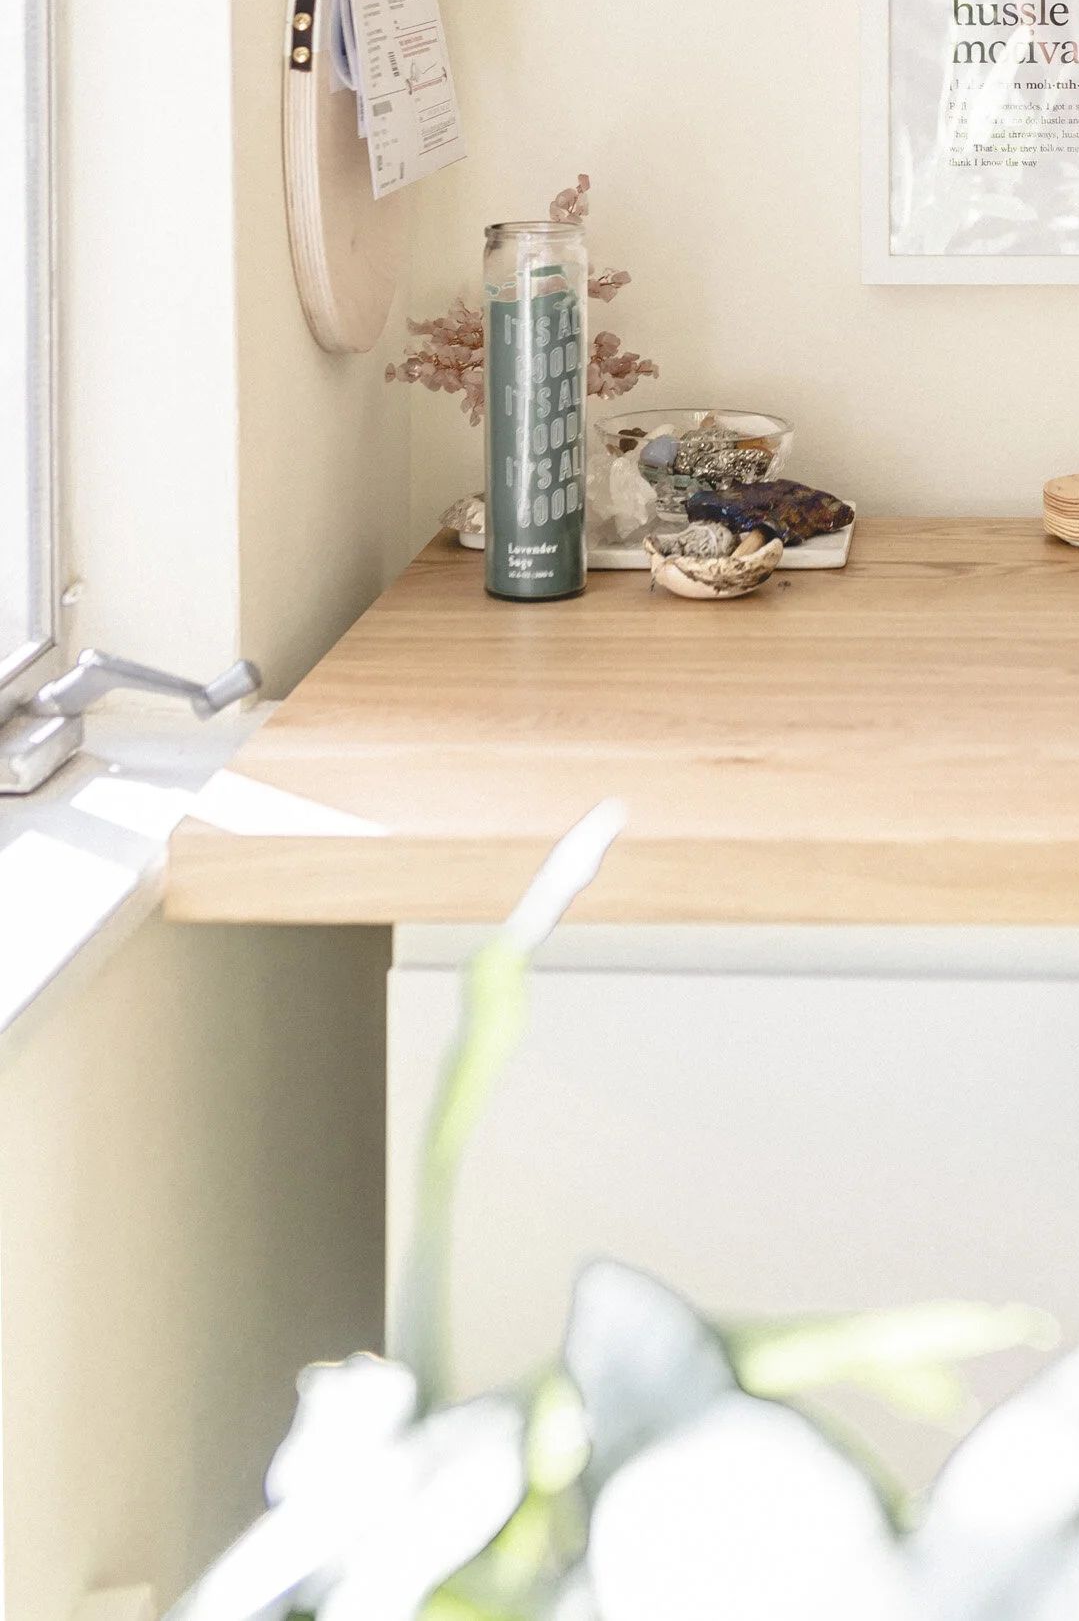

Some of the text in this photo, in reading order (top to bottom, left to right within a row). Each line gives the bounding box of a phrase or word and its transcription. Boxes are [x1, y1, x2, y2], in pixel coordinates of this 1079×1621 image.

[1052, 104, 1065, 112] got
[1040, 116, 1066, 125] hustle
[973, 144, 997, 152] That's
[1000, 144, 1018, 153] why
[1019, 144, 1037, 153] they
[1040, 144, 1065, 152] follow
[981, 158, 1003, 166] know
[1006, 158, 1019, 166] the
[1022, 160, 1037, 168] way
[508, 542, 559, 555] Lavender
[508, 555, 534, 570] Sage
